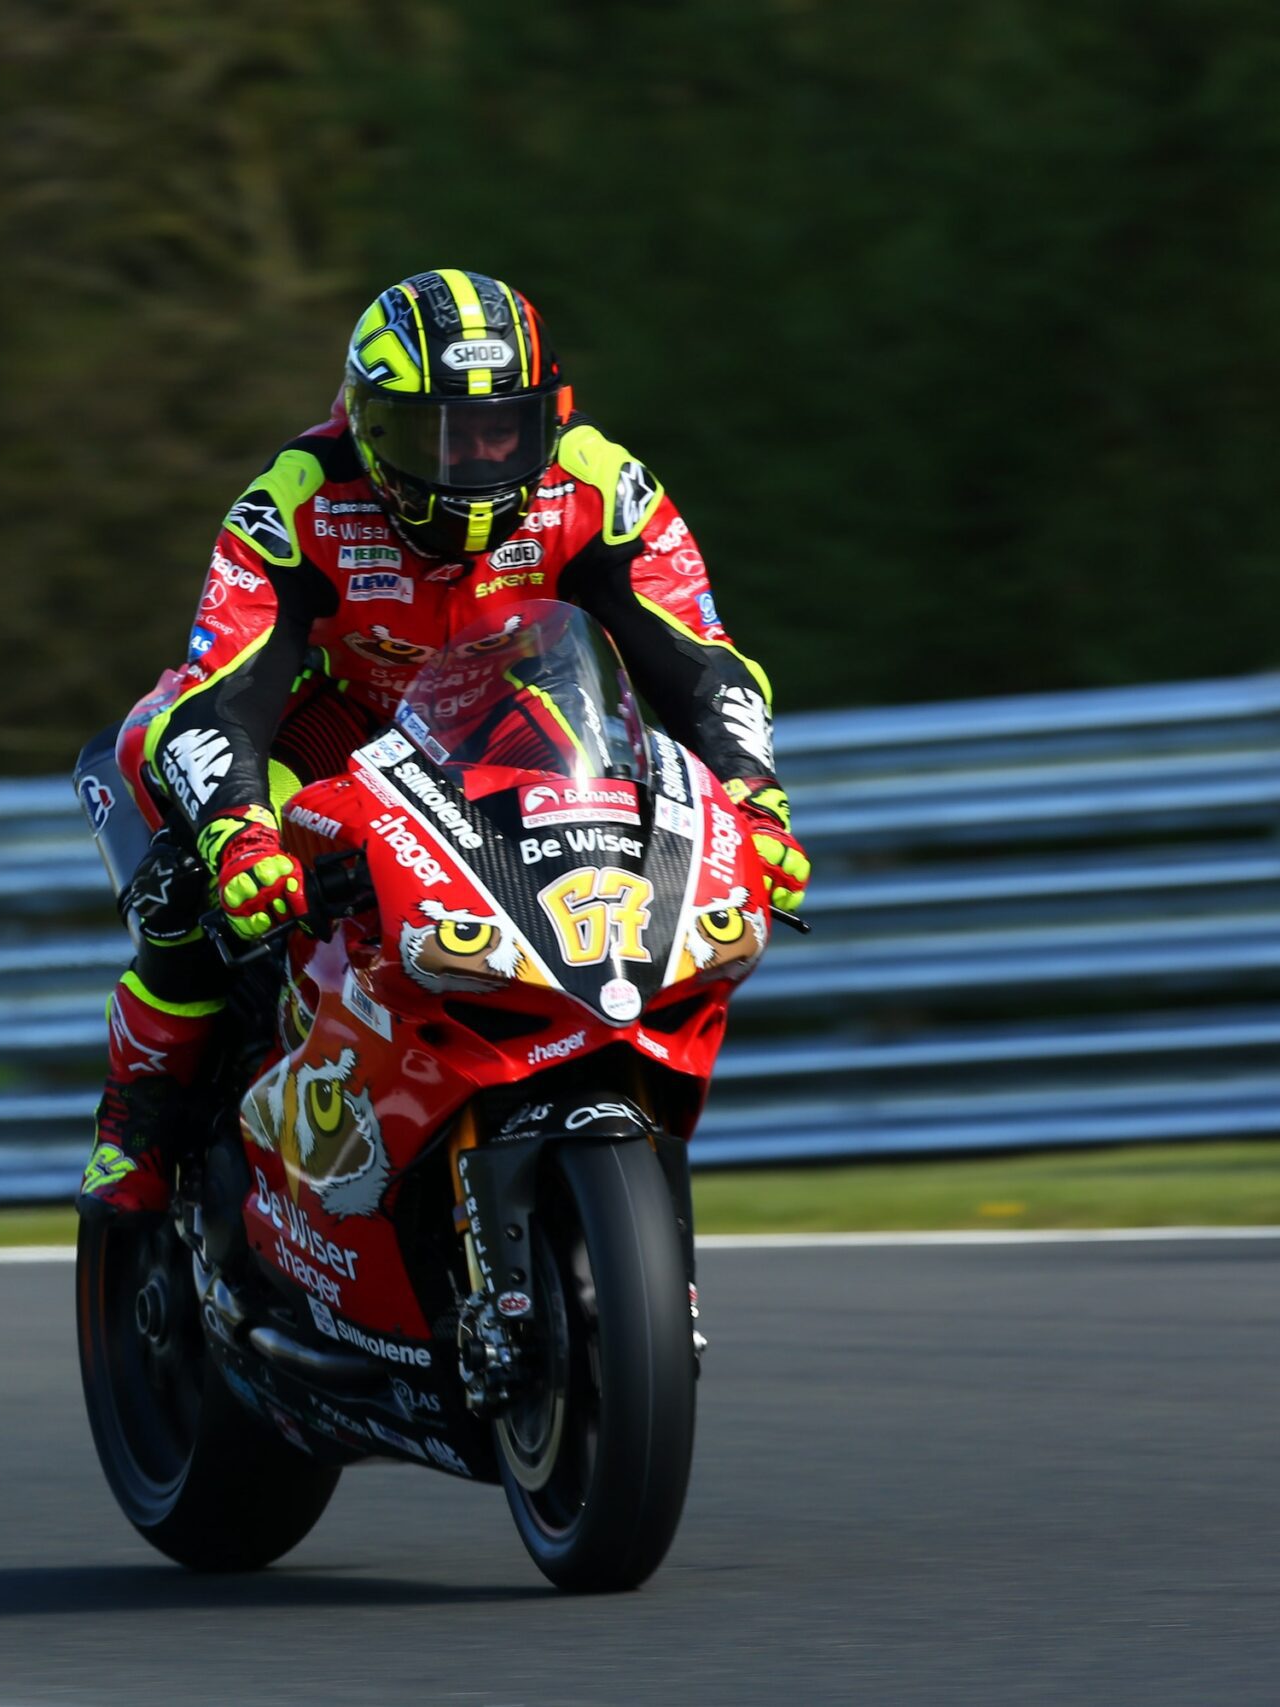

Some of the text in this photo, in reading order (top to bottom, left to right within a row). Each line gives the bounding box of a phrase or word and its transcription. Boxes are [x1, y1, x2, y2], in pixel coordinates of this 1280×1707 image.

[453, 345, 504, 363] SHOEI
[314, 519, 391, 540] Be Wiser
[496, 545, 535, 566] SHOEI
[350, 574, 399, 590] LEW
[204, 614, 235, 636] Group
[161, 750, 200, 821] TOOLS
[287, 805, 343, 841] DUCATI
[393, 761, 484, 851] Silkolene
[519, 827, 644, 866] Be Wiser
[536, 865, 655, 968] 67
[254, 1165, 358, 1281] Be Wiser
[458, 1156, 495, 1294] PIRELLI
[336, 1319, 432, 1367] Silkolene
